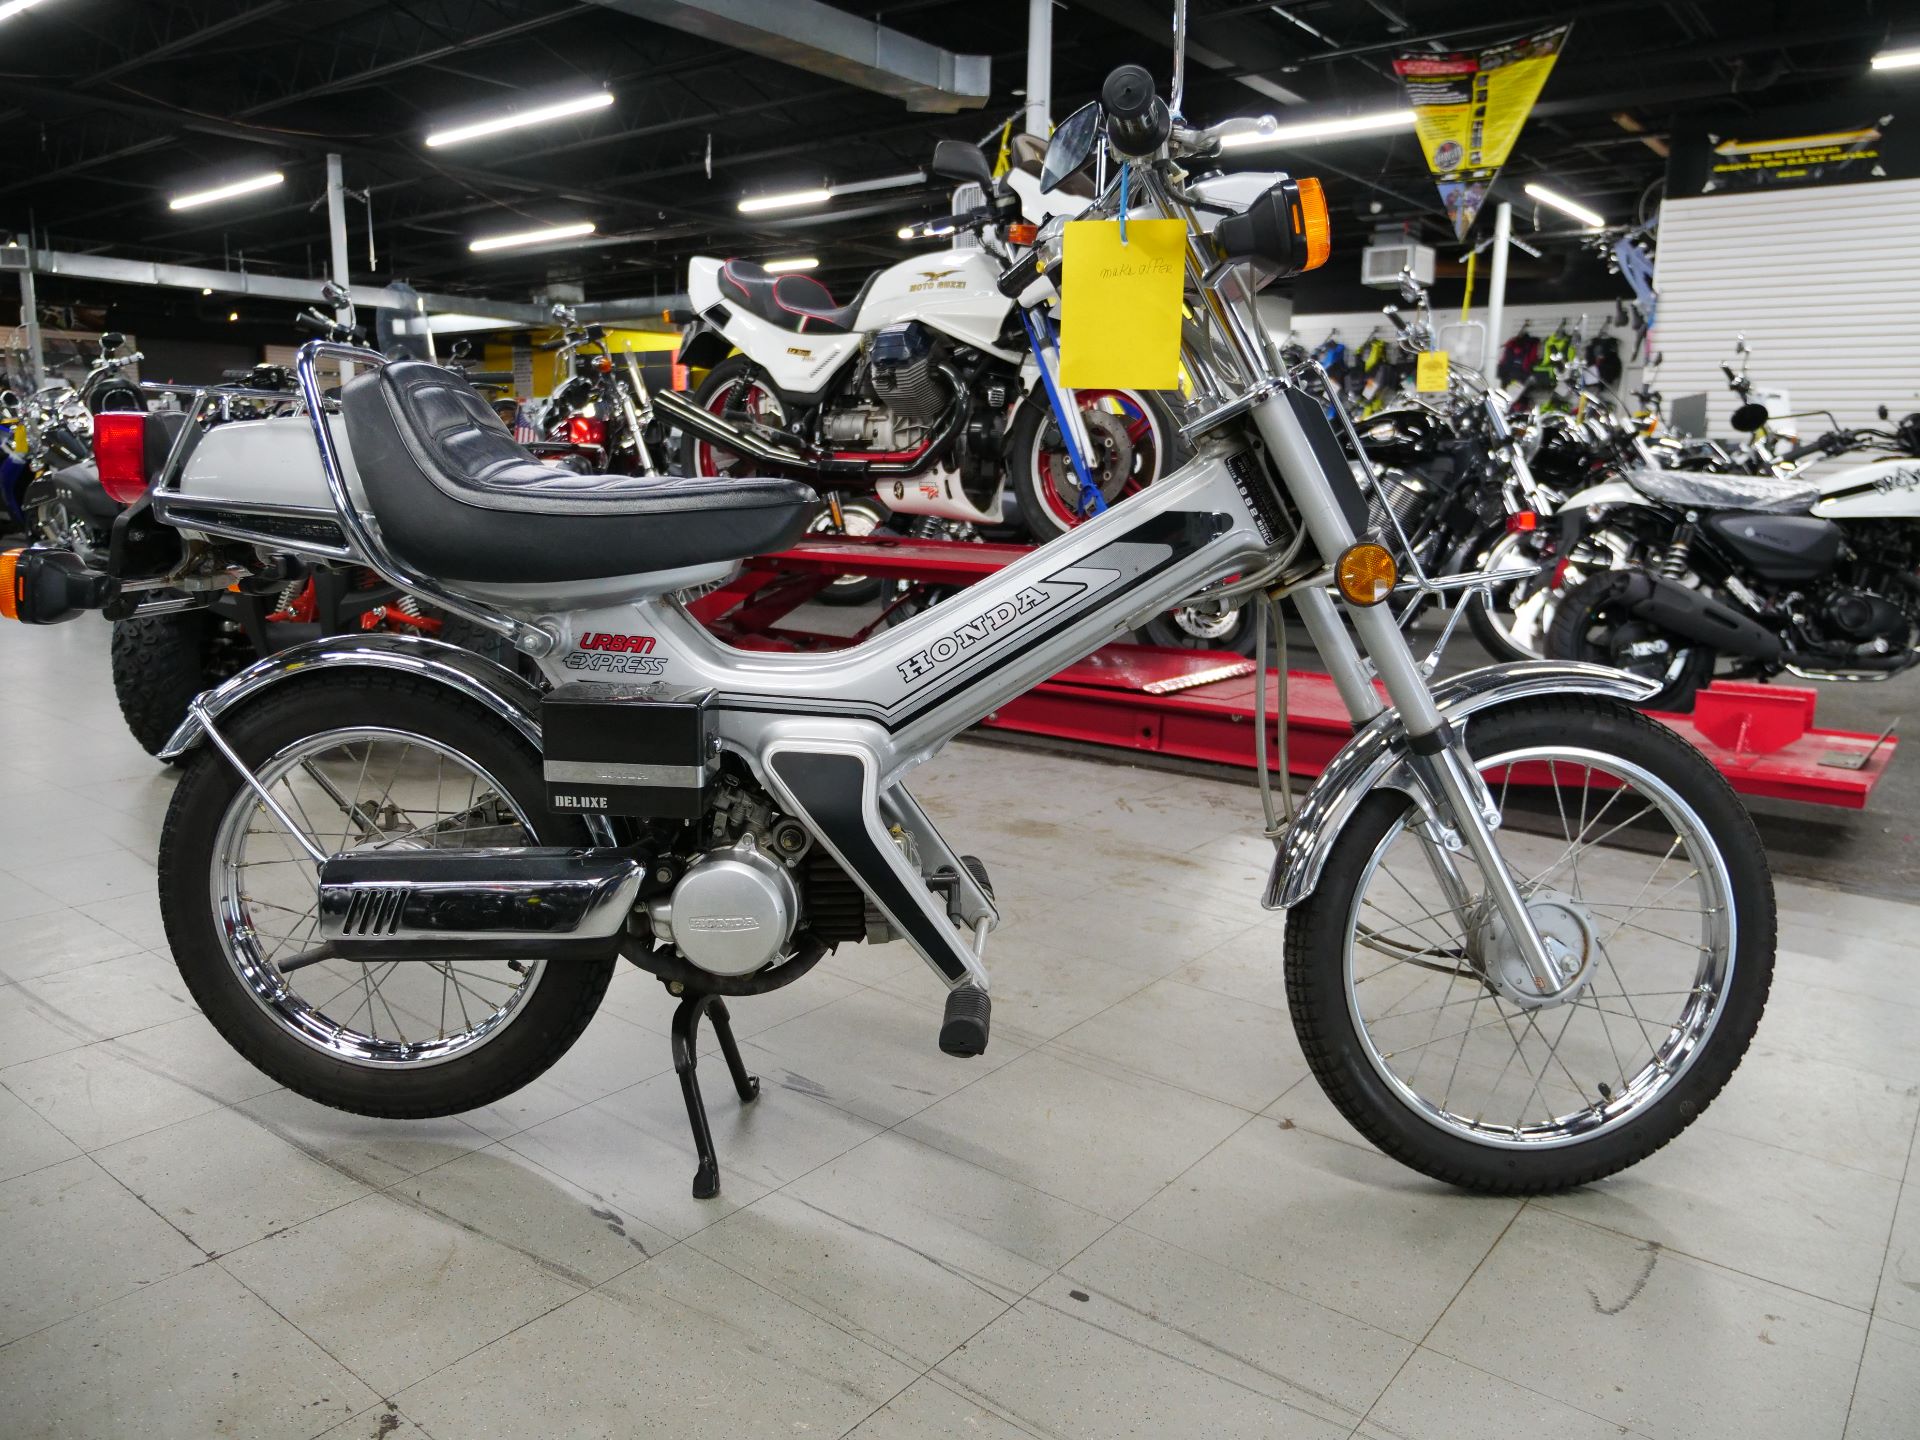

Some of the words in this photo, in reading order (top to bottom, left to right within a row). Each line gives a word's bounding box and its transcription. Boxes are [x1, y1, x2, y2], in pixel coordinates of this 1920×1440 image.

[909, 282, 935, 292] MOTO
[1236, 478, 1258, 517] 1982
[1256, 519, 1271, 541] MODEL
[580, 632, 656, 654] URBAN
[898, 586, 1050, 684] HONDA
[563, 652, 668, 675] EXPRESS
[555, 795, 608, 809] DELUXE
[690, 917, 760, 931] HONDA
